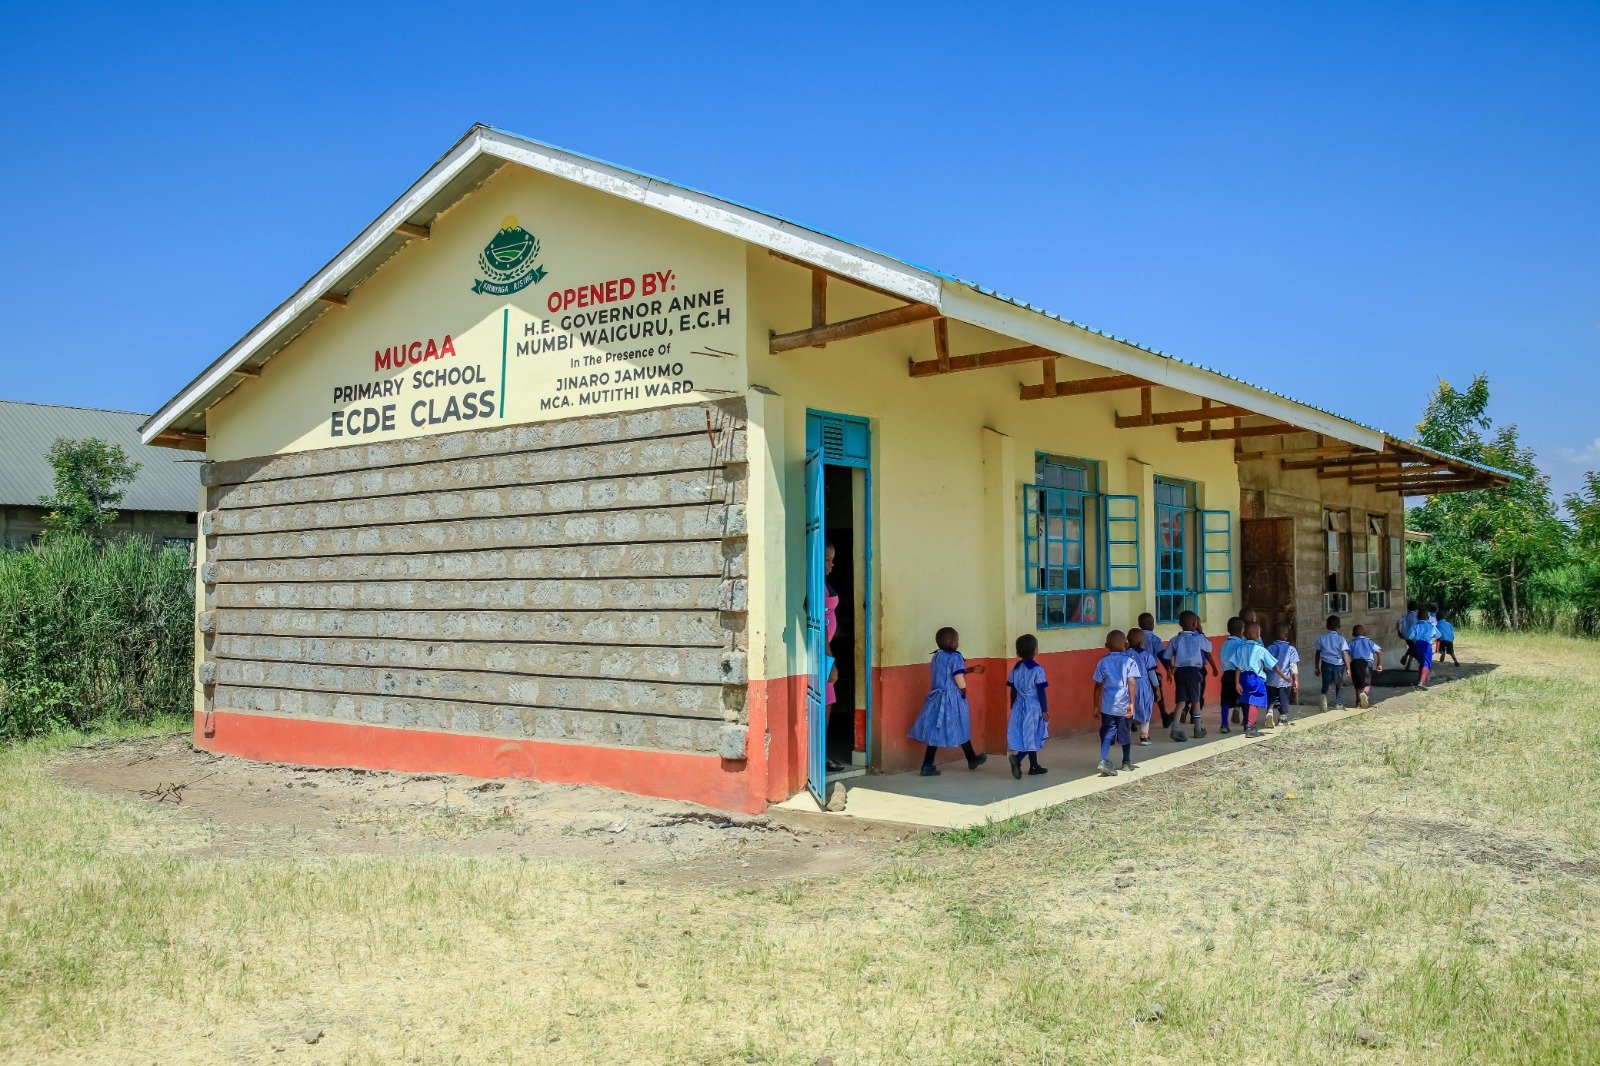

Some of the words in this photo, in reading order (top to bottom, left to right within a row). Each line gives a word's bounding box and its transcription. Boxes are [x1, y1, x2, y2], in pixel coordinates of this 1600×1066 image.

[513, 273, 534, 291] RISING
[547, 277, 636, 313] OPENED
[642, 269, 676, 297] BY:
[516, 334, 574, 357] MUMBI
[580, 318, 674, 348] WAIGURU,
[680, 307, 731, 332] E.G.H
[524, 319, 555, 337] H.E.
[561, 300, 662, 331] GOVERNOR
[668, 289, 725, 313] ANNE
[374, 334, 457, 372] MUGAA
[570, 357, 580, 369] In
[584, 353, 602, 367] The
[605, 346, 654, 363] Presence
[658, 342, 671, 356] Of
[333, 377, 405, 404] PRIMARY
[412, 364, 486, 390] SCHOOL
[540, 396, 574, 411] MCA.
[579, 387, 639, 405] MUTITHI
[645, 379, 694, 398] WARD
[556, 372, 610, 392] JINARO
[614, 362, 684, 384] JAMUMO
[330, 403, 396, 438] ECDE
[410, 389, 496, 428] CLASS
